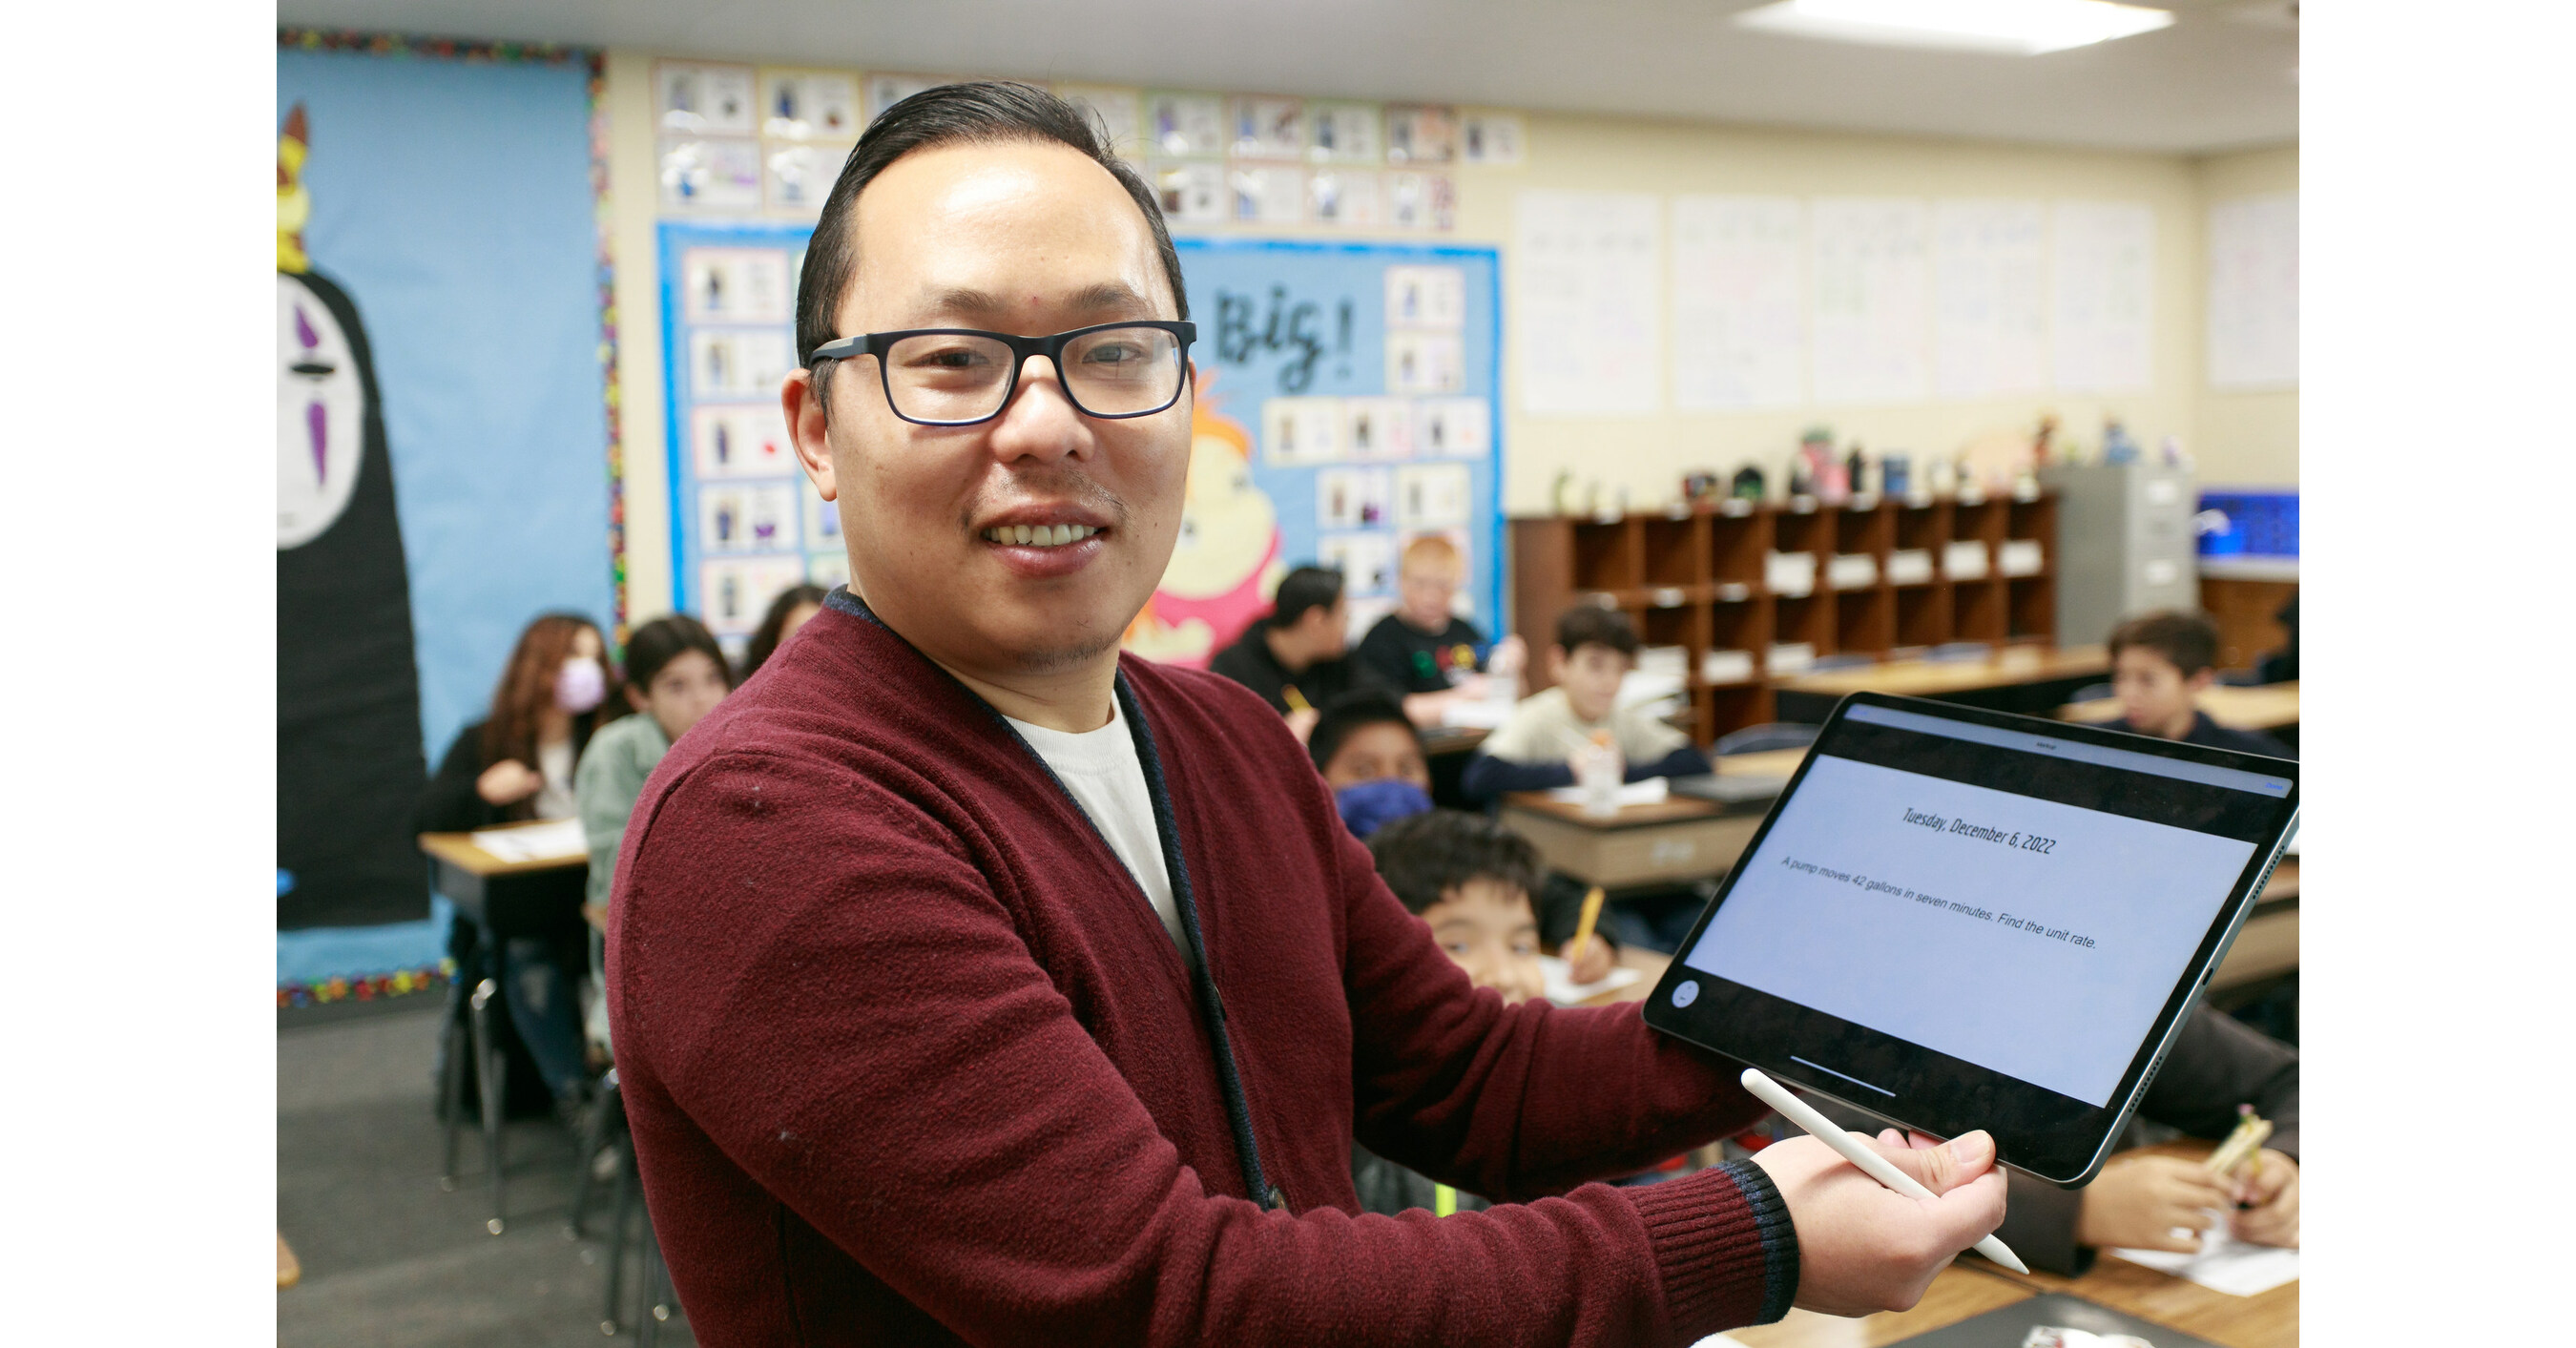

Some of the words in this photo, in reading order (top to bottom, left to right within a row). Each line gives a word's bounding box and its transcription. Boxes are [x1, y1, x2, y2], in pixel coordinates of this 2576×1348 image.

[1902, 807, 1947, 832] Tuesday,
[1949, 818, 2009, 844] December
[2008, 831, 2021, 849] 6,
[2021, 834, 2057, 855] 2022
[1781, 856, 1791, 866] A
[1790, 860, 1818, 874] pump
[1818, 866, 1852, 882] moves
[1852, 875, 1867, 887] 42
[1864, 879, 1903, 897] gallons
[1903, 887, 1915, 900] in
[1915, 893, 1948, 909] seven
[1948, 902, 1993, 922] minutes.
[1997, 912, 2024, 929] Find
[2025, 921, 2045, 935] the
[2046, 927, 2069, 942] unit
[2069, 933, 2096, 949] rate.
